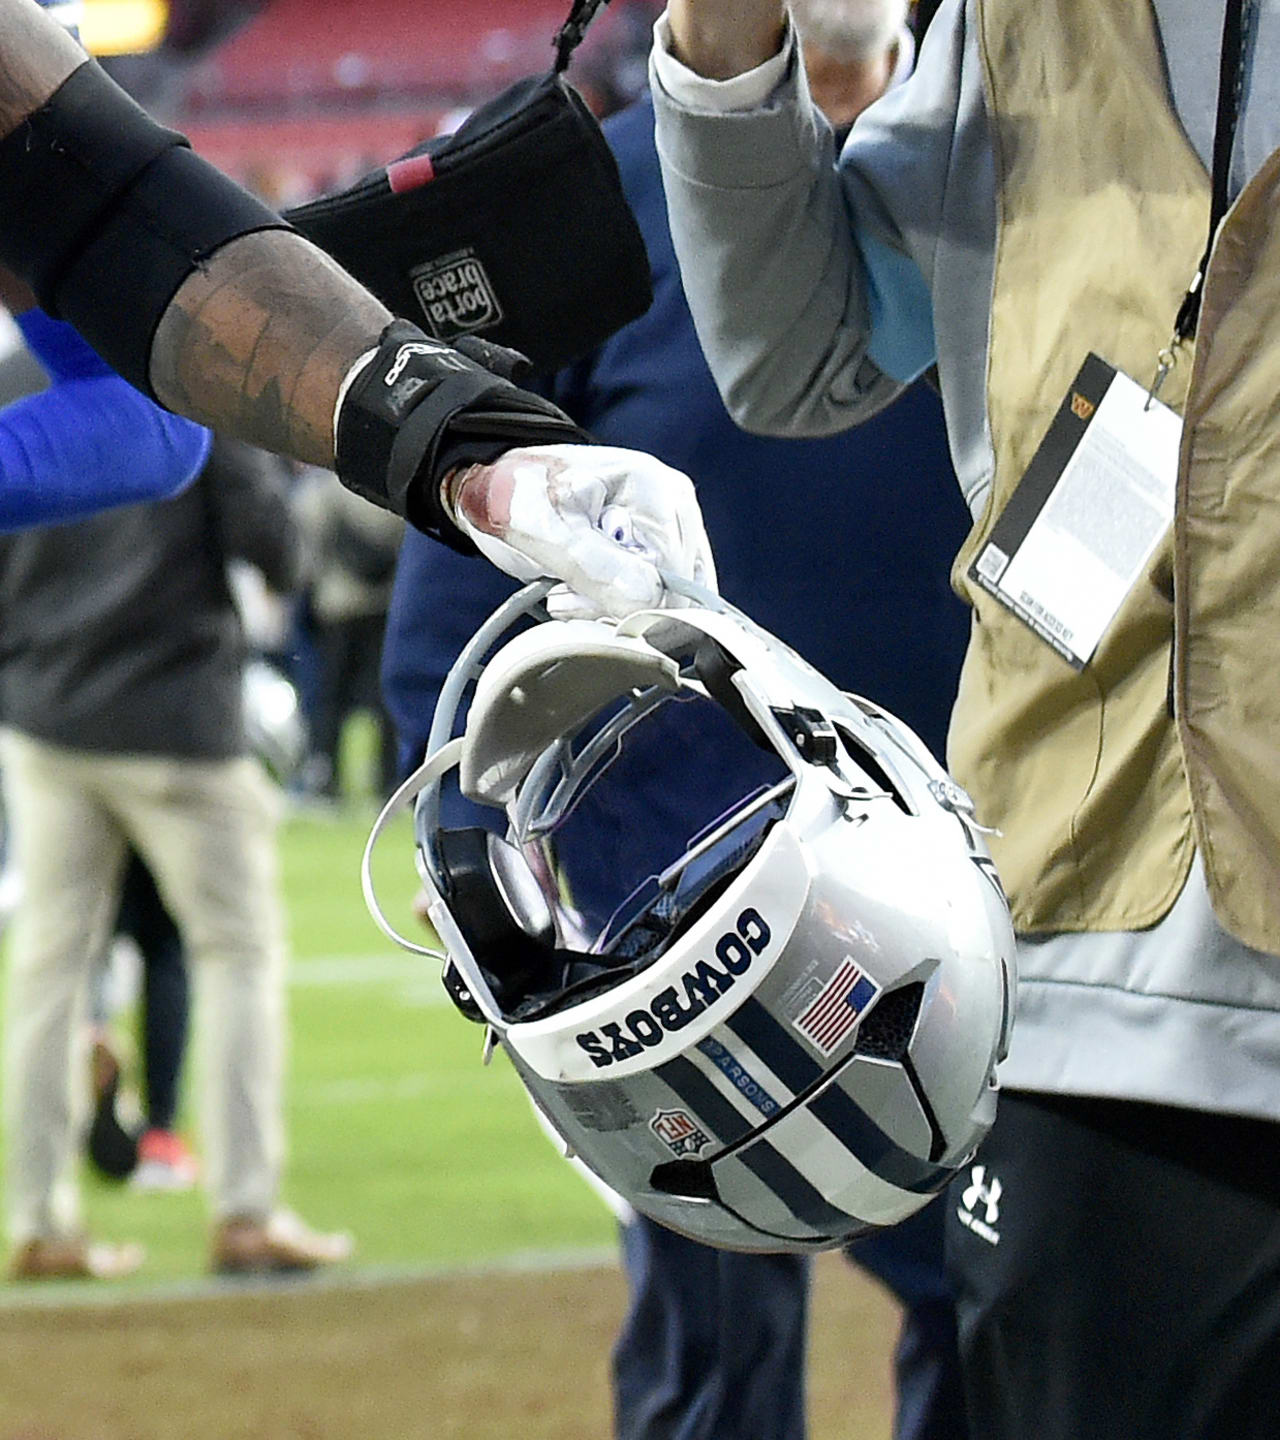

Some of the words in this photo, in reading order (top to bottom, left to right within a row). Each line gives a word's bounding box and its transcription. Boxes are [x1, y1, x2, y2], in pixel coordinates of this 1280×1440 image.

[419, 263, 484, 301] brace
[429, 286, 492, 325] porta
[575, 907, 772, 1068] COWBOYS
[655, 1114, 695, 1140] NFL
